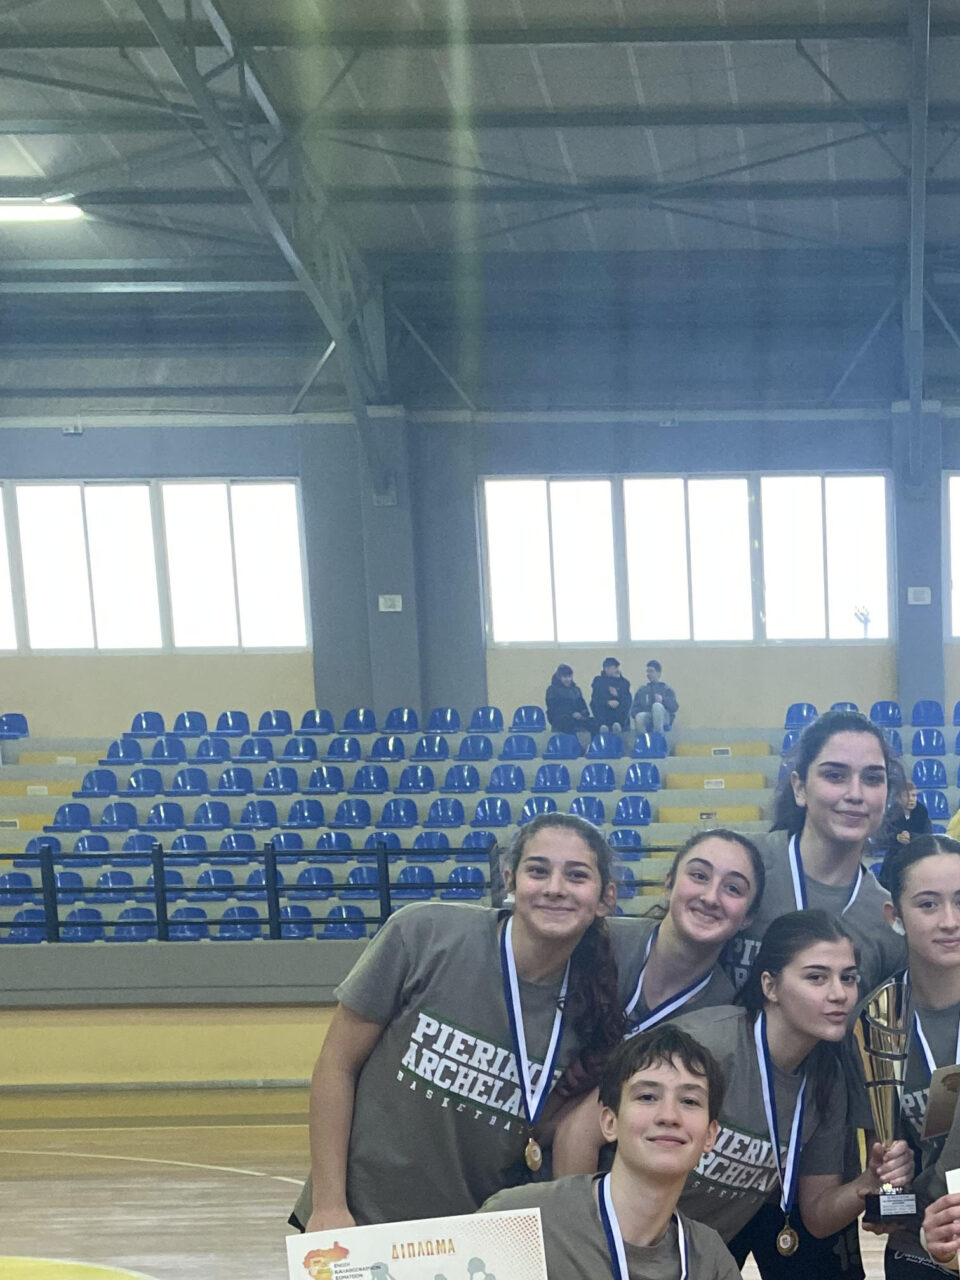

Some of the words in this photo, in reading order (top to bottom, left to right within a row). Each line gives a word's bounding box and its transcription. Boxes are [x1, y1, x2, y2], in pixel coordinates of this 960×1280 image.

[397, 1070, 524, 1134] BASKETBA
[402, 1041, 528, 1119] ARCHELA
[391, 1238, 456, 1260] ΔΙΠΛΩΜΑ
